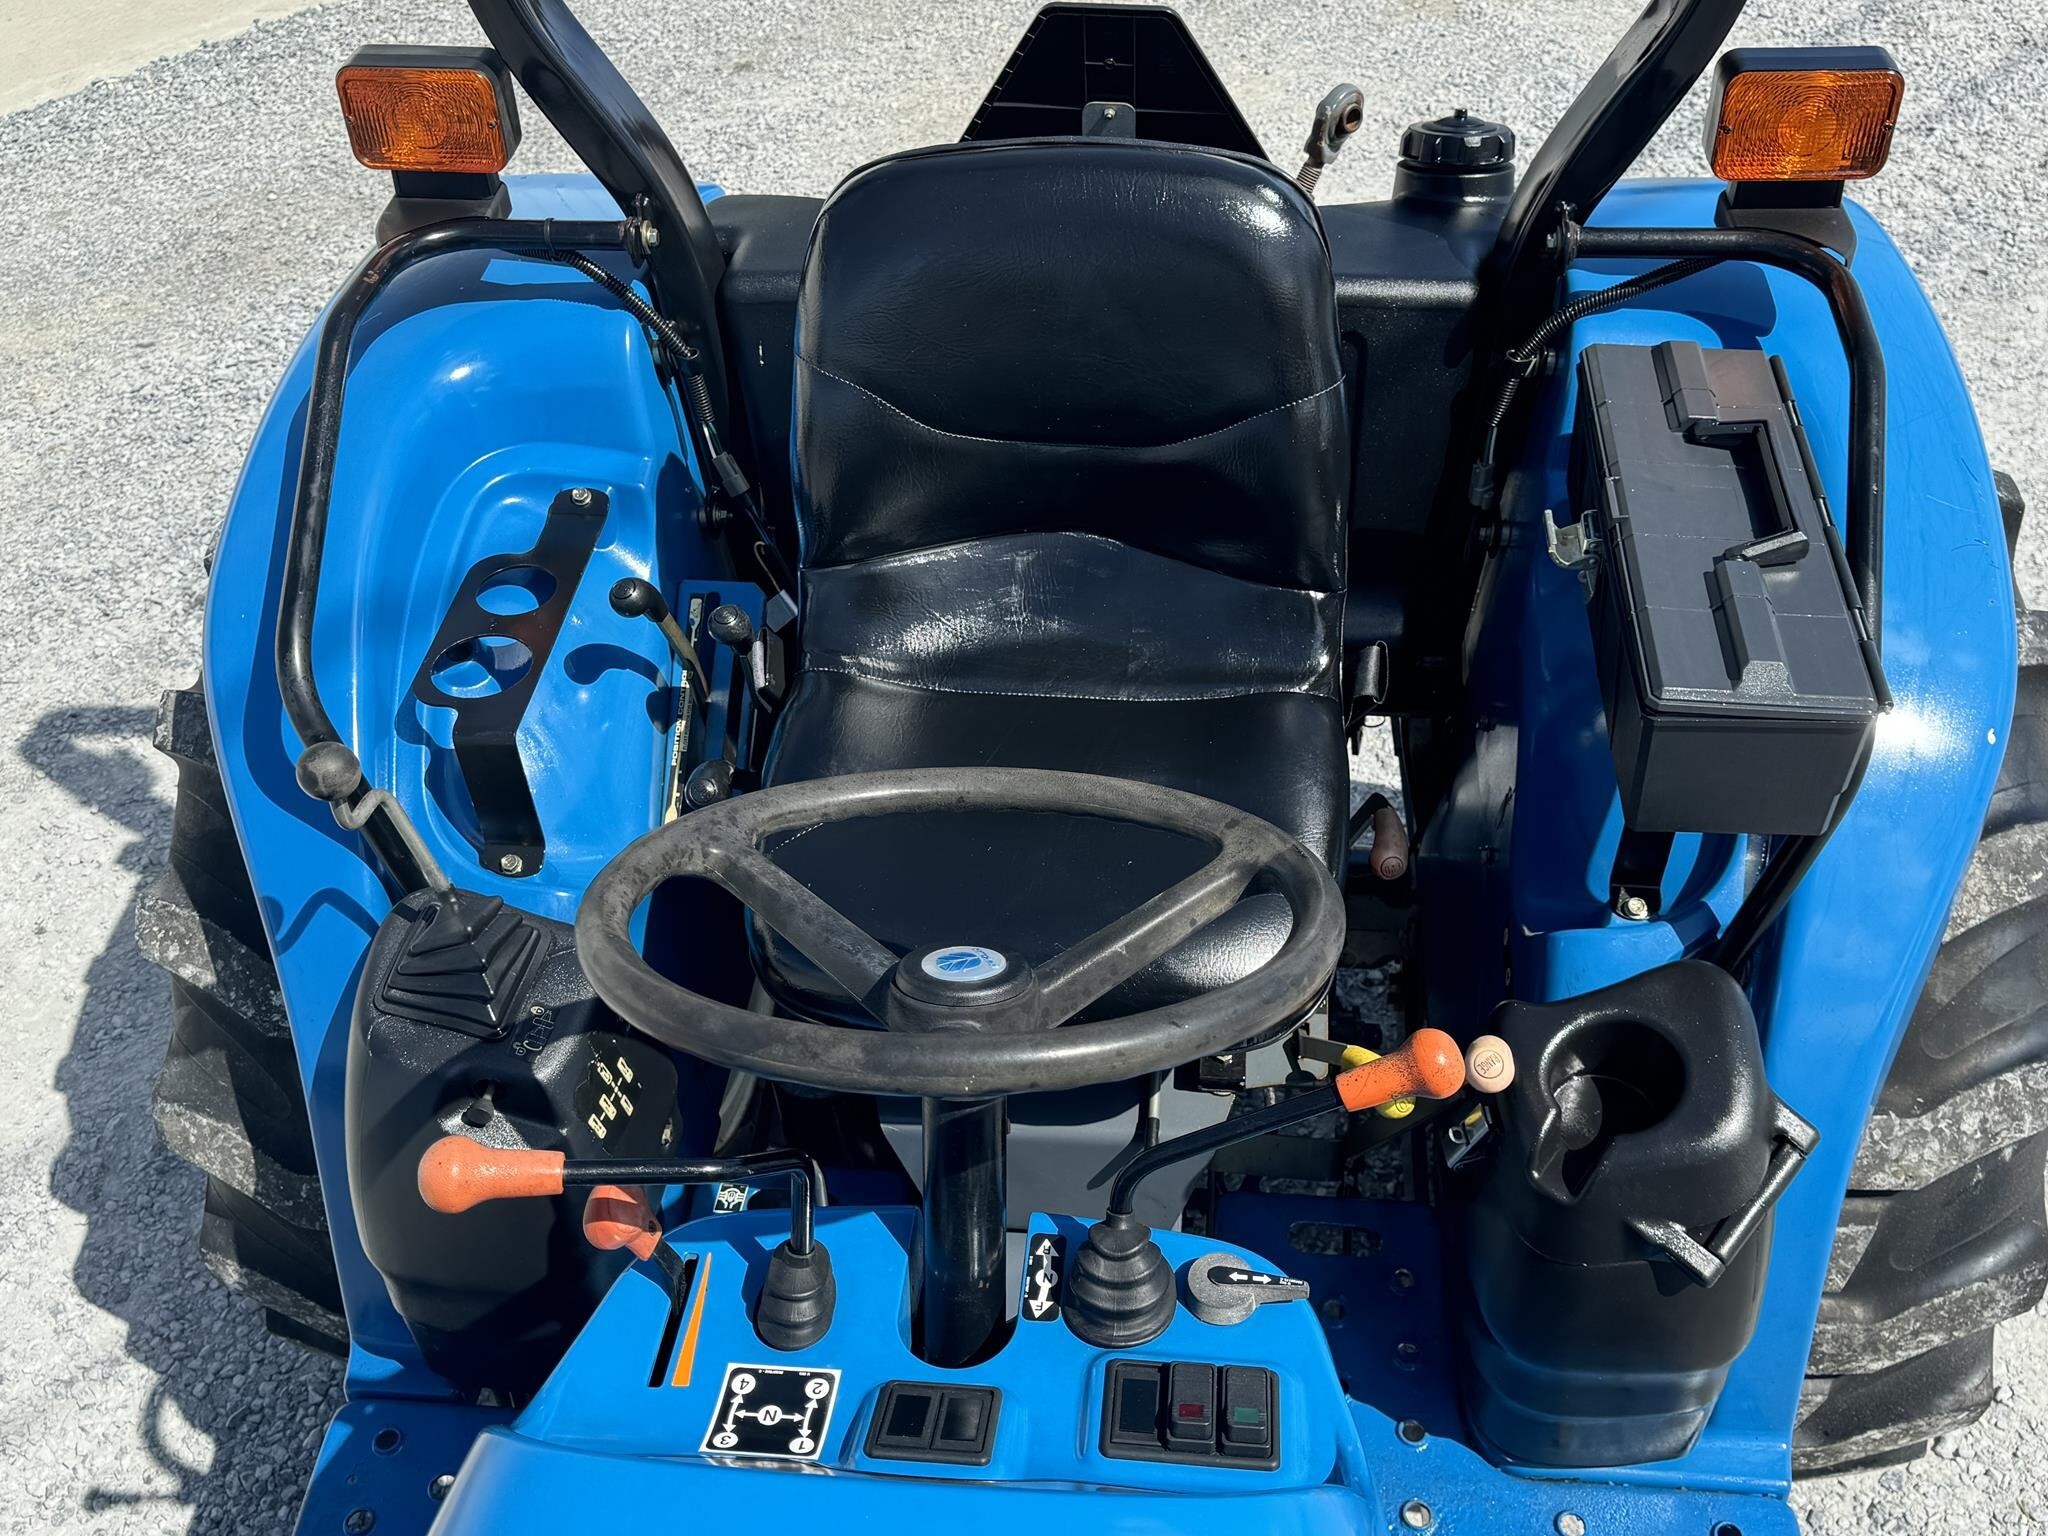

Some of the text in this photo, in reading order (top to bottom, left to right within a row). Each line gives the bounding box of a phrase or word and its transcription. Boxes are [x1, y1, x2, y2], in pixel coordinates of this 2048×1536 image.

[671, 720, 682, 766] POSITION
[1476, 1053, 1501, 1075] RANGE
[1043, 1273, 1053, 1283] N
[739, 1378, 750, 1390] 4
[812, 1382, 824, 1395] 2
[763, 1409, 778, 1422] N
[720, 1435, 731, 1445] 3
